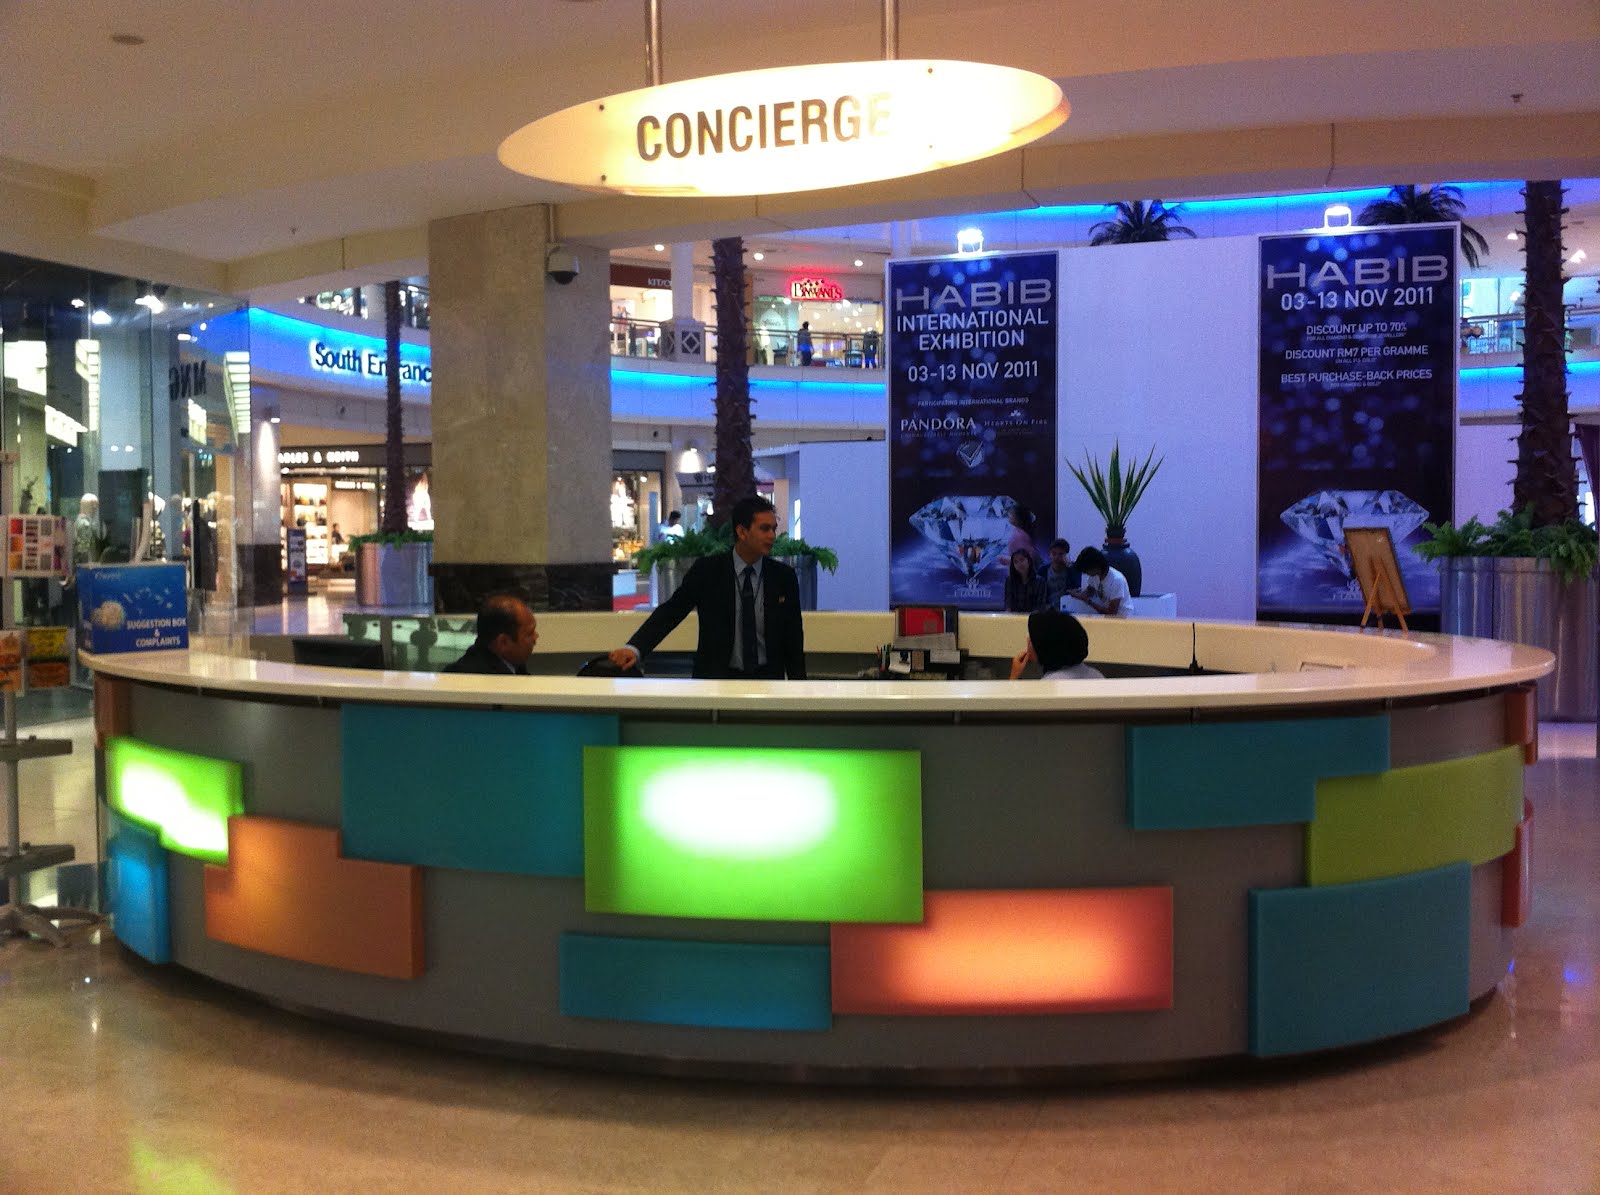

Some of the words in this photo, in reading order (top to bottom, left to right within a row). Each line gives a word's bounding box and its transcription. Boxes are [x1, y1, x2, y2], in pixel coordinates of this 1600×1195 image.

[636, 91, 892, 162] CONCIERGE
[1267, 255, 1448, 289] HABIB
[896, 278, 1052, 312] HABIB
[1281, 291, 1338, 311] 03-13
[1344, 289, 1389, 309] NOV
[1393, 286, 1433, 306] 2011
[897, 307, 1049, 333] INTERNATIONAL
[1306, 323, 1357, 335] DISCOUNT
[1358, 323, 1373, 334] UP
[1375, 322, 1388, 332] TO
[1389, 321, 1407, 332] 70%
[919, 329, 1025, 351] EXHIBITION
[315, 342, 363, 374] South
[367, 352, 431, 383] Enanc
[1285, 348, 1336, 360] DISCOUNT
[1337, 348, 1359, 358] RM7
[1360, 347, 1381, 357] PER
[1383, 345, 1428, 356] GRAMME
[908, 364, 957, 382] 03-13
[962, 361, 999, 380] NOV
[1004, 360, 1038, 379] 2011
[1281, 373, 1307, 384] BEST
[1308, 370, 1395, 383] PURCHASE-BACK
[1396, 369, 1433, 380] PRICES
[959, 398, 1003, 406] INTERNATIONAL
[900, 417, 977, 432] PANDORA
[127, 618, 171, 630] SUGGESTION
[172, 617, 186, 627] BOX
[135, 636, 181, 648] COMPLAINTS
